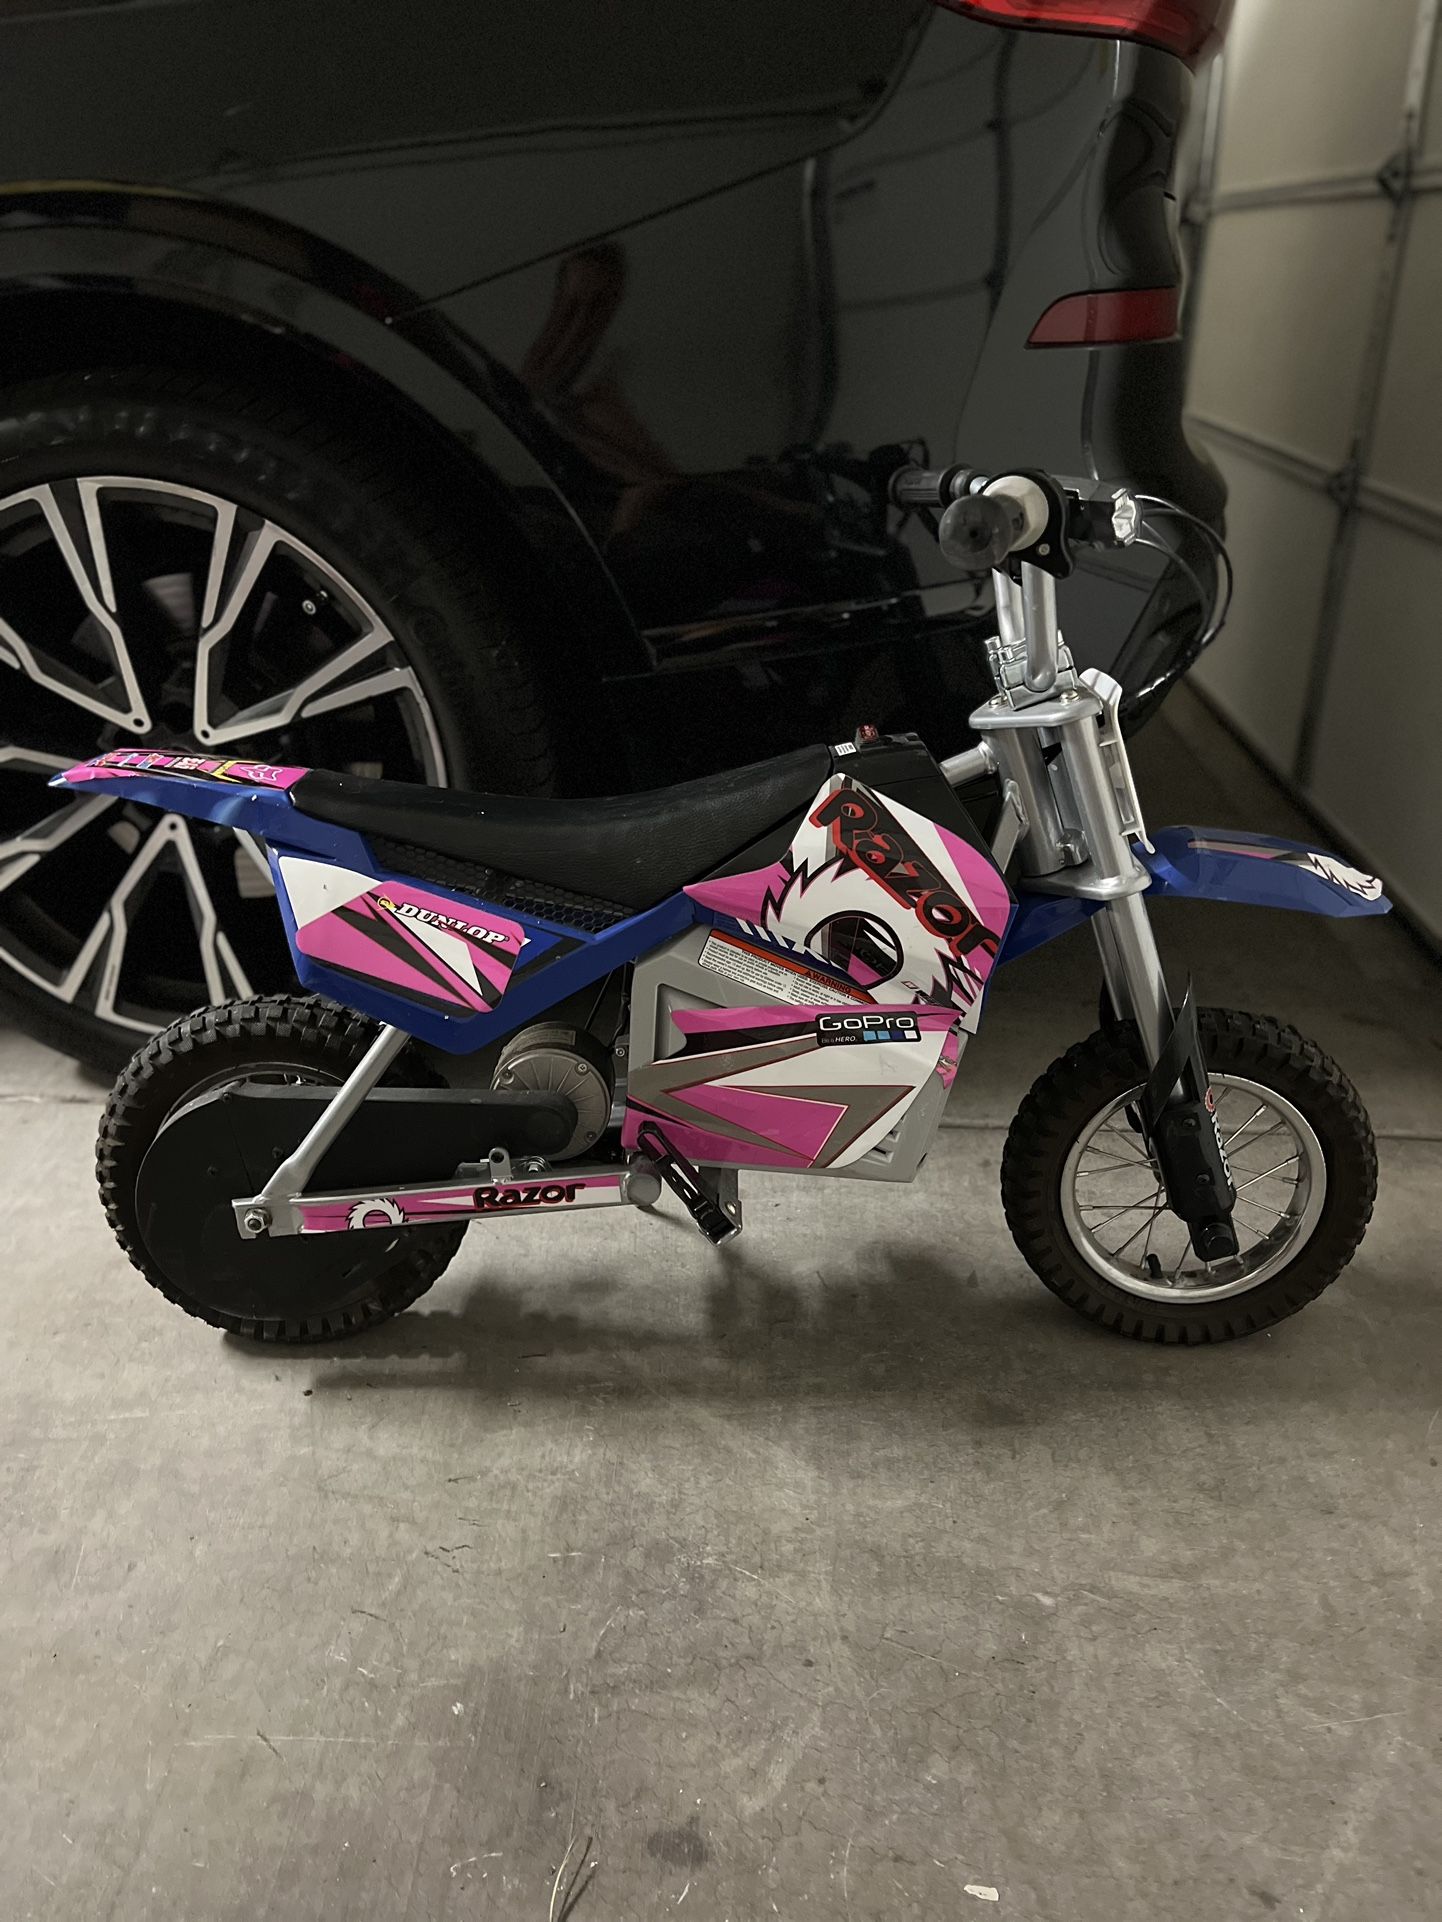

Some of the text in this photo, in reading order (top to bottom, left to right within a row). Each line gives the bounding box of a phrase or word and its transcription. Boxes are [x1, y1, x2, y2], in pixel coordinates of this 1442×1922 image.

[808, 788, 1001, 957] Razor
[395, 902, 507, 944] DUNLOP
[809, 970, 851, 994] WARNING
[819, 1015, 914, 1031] GoPro
[473, 1183, 586, 1211] Razor
